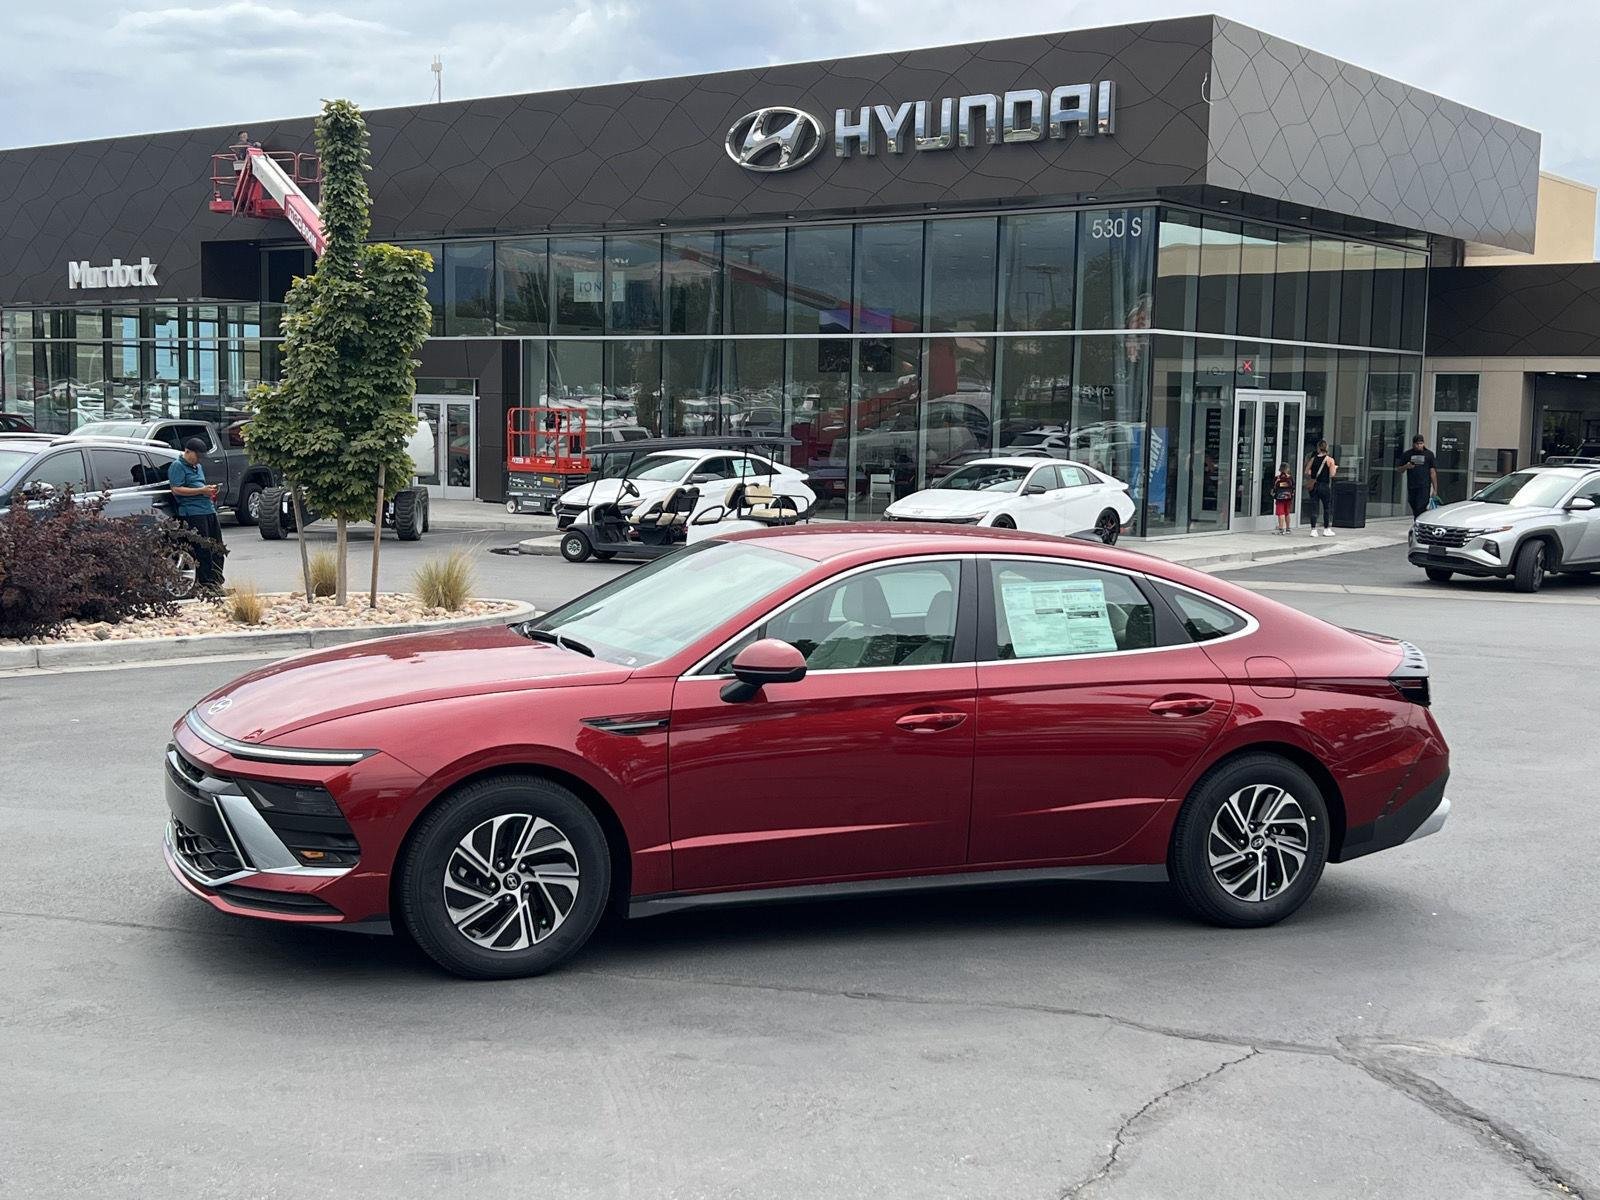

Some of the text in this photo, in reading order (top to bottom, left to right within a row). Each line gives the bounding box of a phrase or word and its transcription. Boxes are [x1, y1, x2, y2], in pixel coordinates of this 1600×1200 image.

[835, 80, 1117, 158] HYUNDAI
[1092, 217, 1142, 239] 530 S
[68, 257, 159, 289] Murdock
